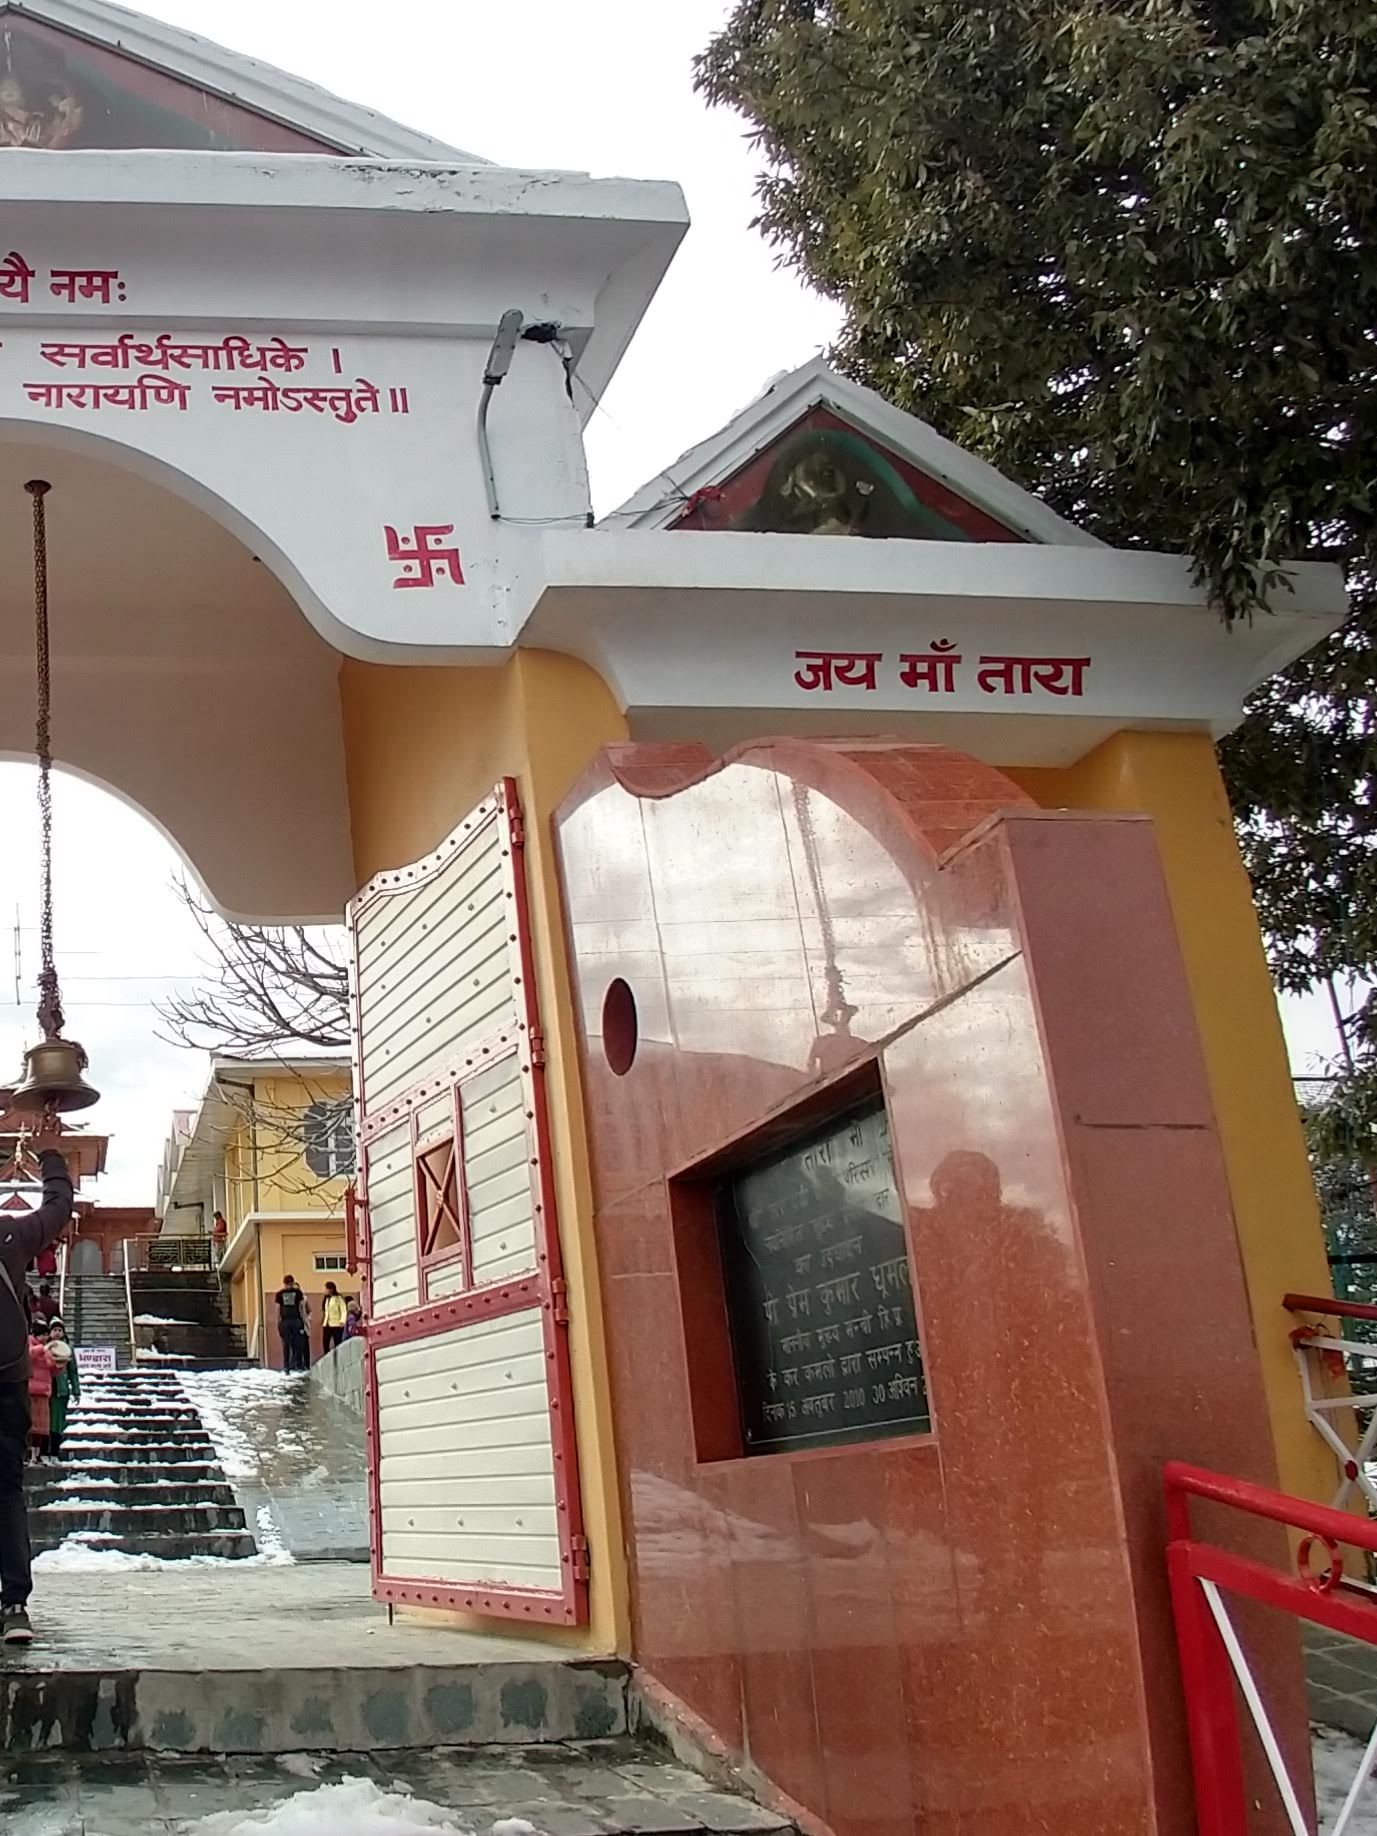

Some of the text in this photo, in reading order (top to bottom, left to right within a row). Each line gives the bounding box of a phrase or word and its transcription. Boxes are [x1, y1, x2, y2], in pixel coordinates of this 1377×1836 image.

[51, 269, 128, 305] नमः
[40, 335, 308, 373] सर्वार्थसाधिके
[23, 374, 191, 411] नारायणि
[793, 638, 1091, 697] जय माँ तारा
[815, 1271, 861, 1315] कुमार
[872, 1385, 885, 1405] 30
